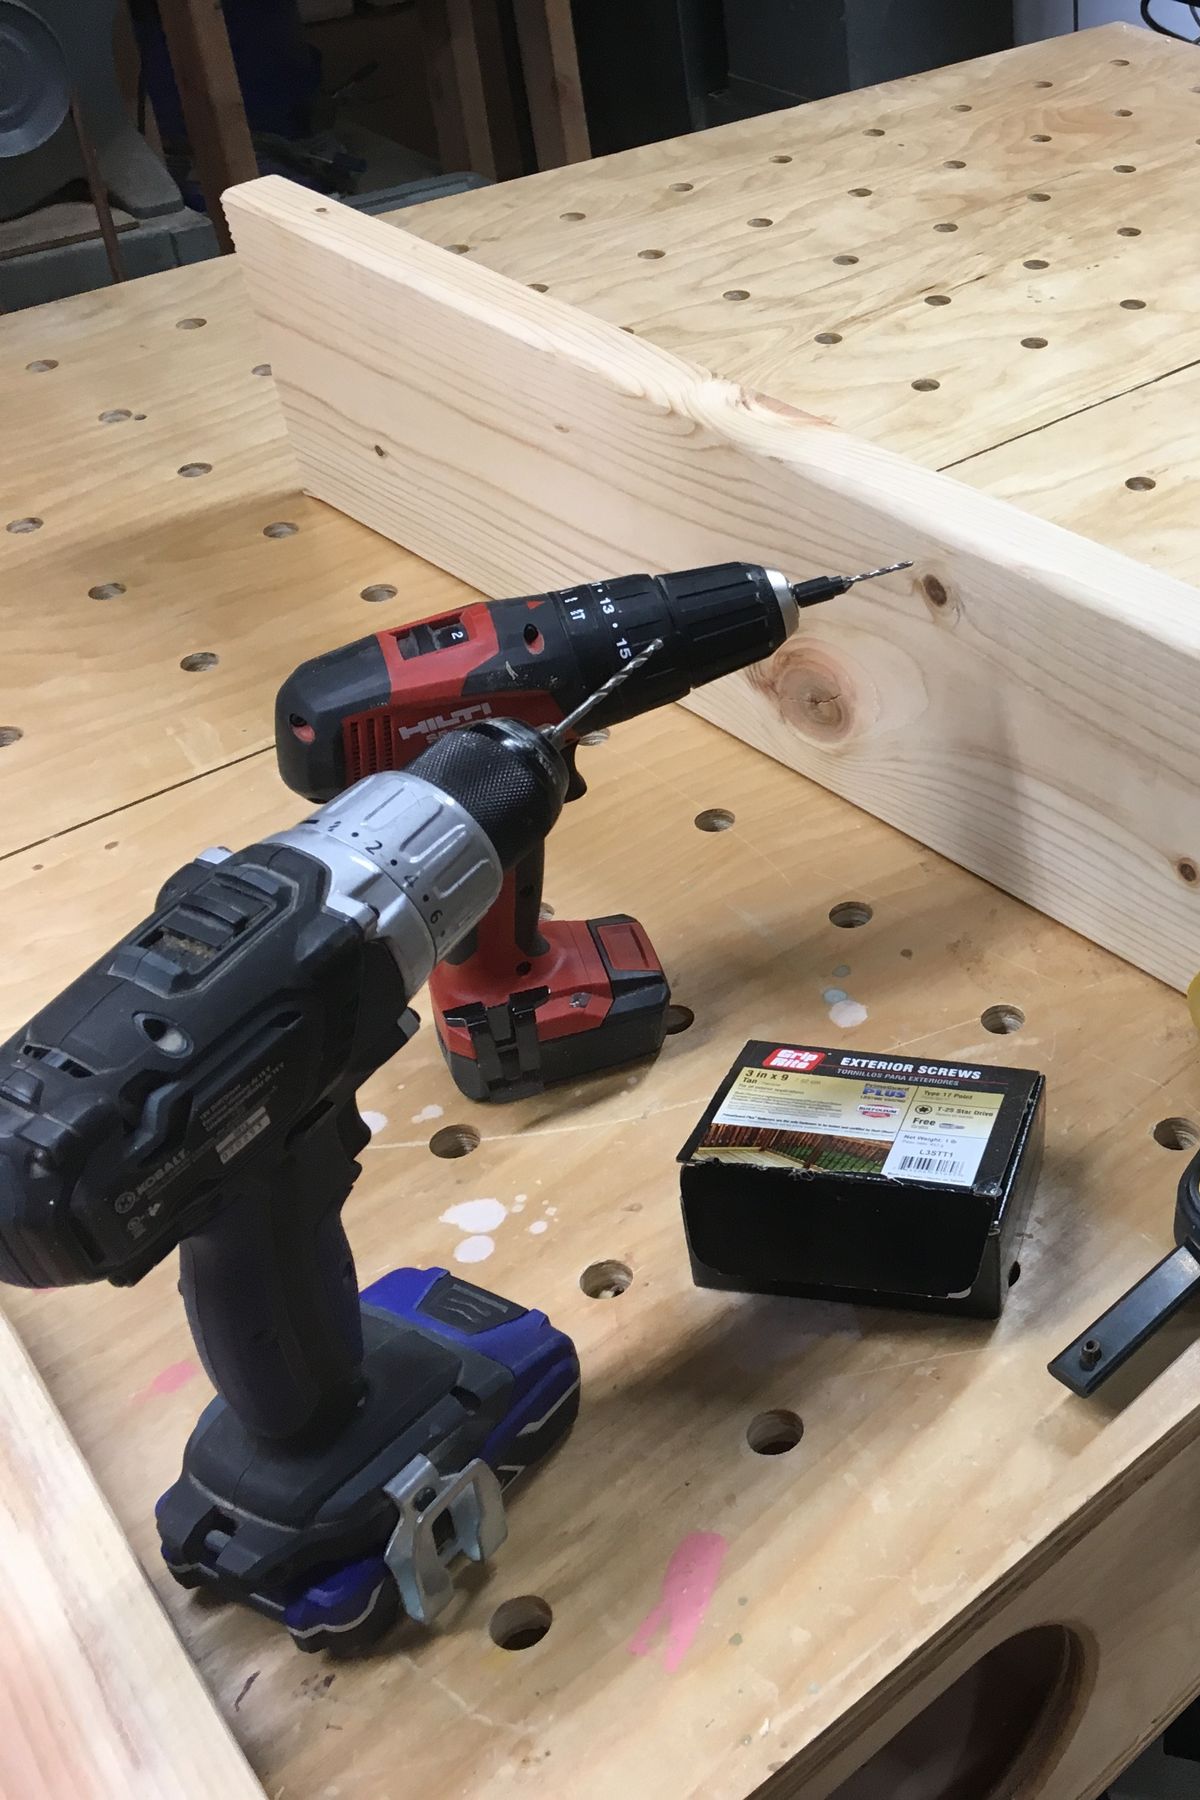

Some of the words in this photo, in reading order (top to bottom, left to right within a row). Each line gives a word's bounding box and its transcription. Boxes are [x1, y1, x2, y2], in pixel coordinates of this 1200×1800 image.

[599, 597, 615, 615] 13
[450, 630, 464, 640] 2
[616, 637, 632, 660] 15
[398, 702, 492, 740] HILTI
[364, 840, 383, 855] 2
[403, 873, 419, 888] 4
[429, 909, 443, 925] 6
[776, 1049, 819, 1062] Grip
[769, 1058, 810, 1070] Rite
[840, 1057, 914, 1073] EXTERIOR
[917, 1065, 982, 1080] SCREWS
[745, 1069, 754, 1078] 3
[756, 1071, 767, 1079] in
[836, 1068, 883, 1079] TORNILLOS
[884, 1073, 907, 1081] PARA
[908, 1076, 960, 1087] EXTERIORES
[862, 1087, 907, 1099] PLUS
[923, 1090, 941, 1098] Type
[973, 1109, 994, 1117] Drive
[912, 1117, 936, 1127] Free
[136, 1148, 187, 1195] KOBALT
